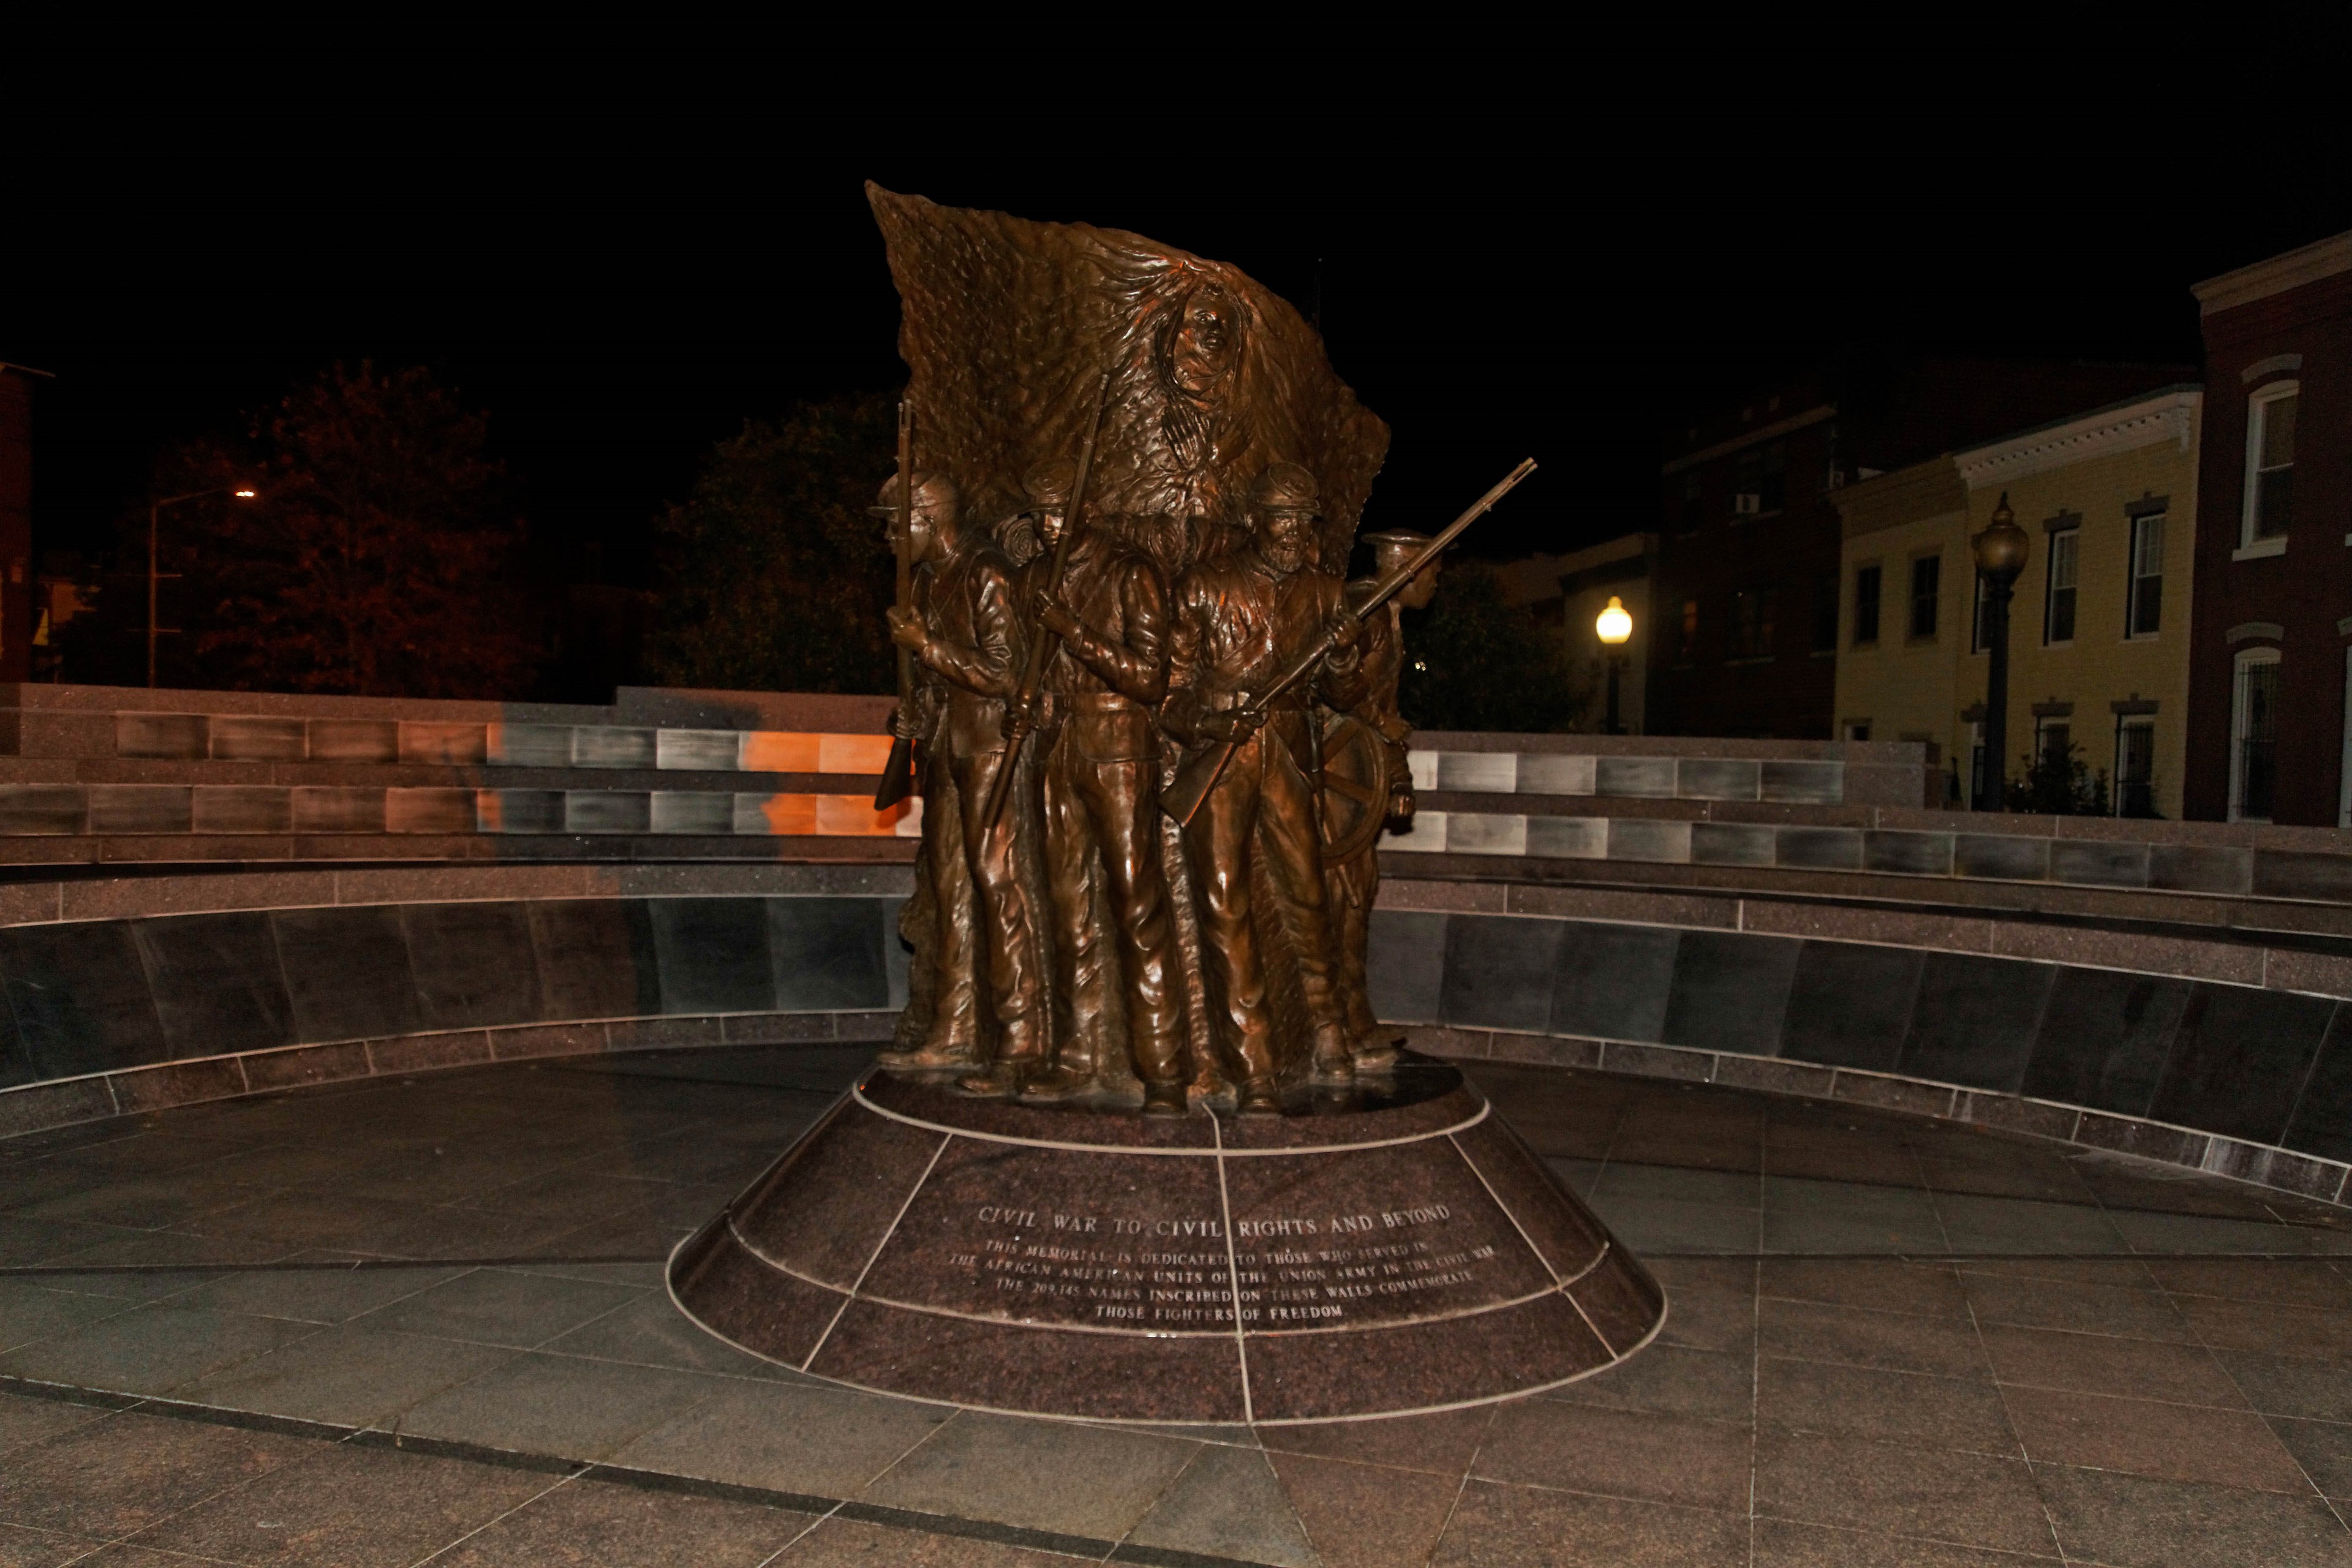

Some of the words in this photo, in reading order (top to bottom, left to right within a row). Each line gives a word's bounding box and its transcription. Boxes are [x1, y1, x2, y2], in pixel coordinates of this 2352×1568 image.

[978, 1206, 1037, 1227] CIVIL
[1054, 1215, 1097, 1232] WAR
[1114, 1219, 1141, 1235] TO
[1156, 1219, 1223, 1237] CIVIL
[1239, 1218, 1317, 1237] RIGHTS
[1332, 1215, 1373, 1234] AND
[1382, 1204, 1450, 1228] BEYOND
[986, 1239, 1017, 1254] THIS
[1027, 1245, 1106, 1262] MEMORIAL
[1118, 1253, 1132, 1264] IS
[1142, 1253, 1228, 1265] DEDICATED
[1237, 1254, 1256, 1265] TO
[1266, 1251, 1311, 1264] THOSE
[1319, 1250, 1351, 1263] WHO
[986, 1259, 1052, 1276] AFRICAN
[1059, 1266, 1144, 1282] AMERICAN
[1154, 1270, 1202, 1284] UNITS
[1212, 1271, 1229, 1283] OF
[1239, 1272, 1268, 1283] THE
[1279, 1268, 1326, 1282] UNION
[1383, 1263, 1400, 1275] IN
[997, 1278, 1024, 1292] THE
[1088, 1286, 1140, 1301] NAMES
[1150, 1289, 1232, 1302] INSCRIBED
[1240, 1291, 1261, 1302] ON
[1272, 1288, 1319, 1302] THESE
[1325, 1284, 1373, 1298] WALLS
[1096, 1305, 1144, 1320] THOSE
[1155, 1308, 1235, 1321] FIGHTERS
[1242, 1308, 1261, 1321] OF
